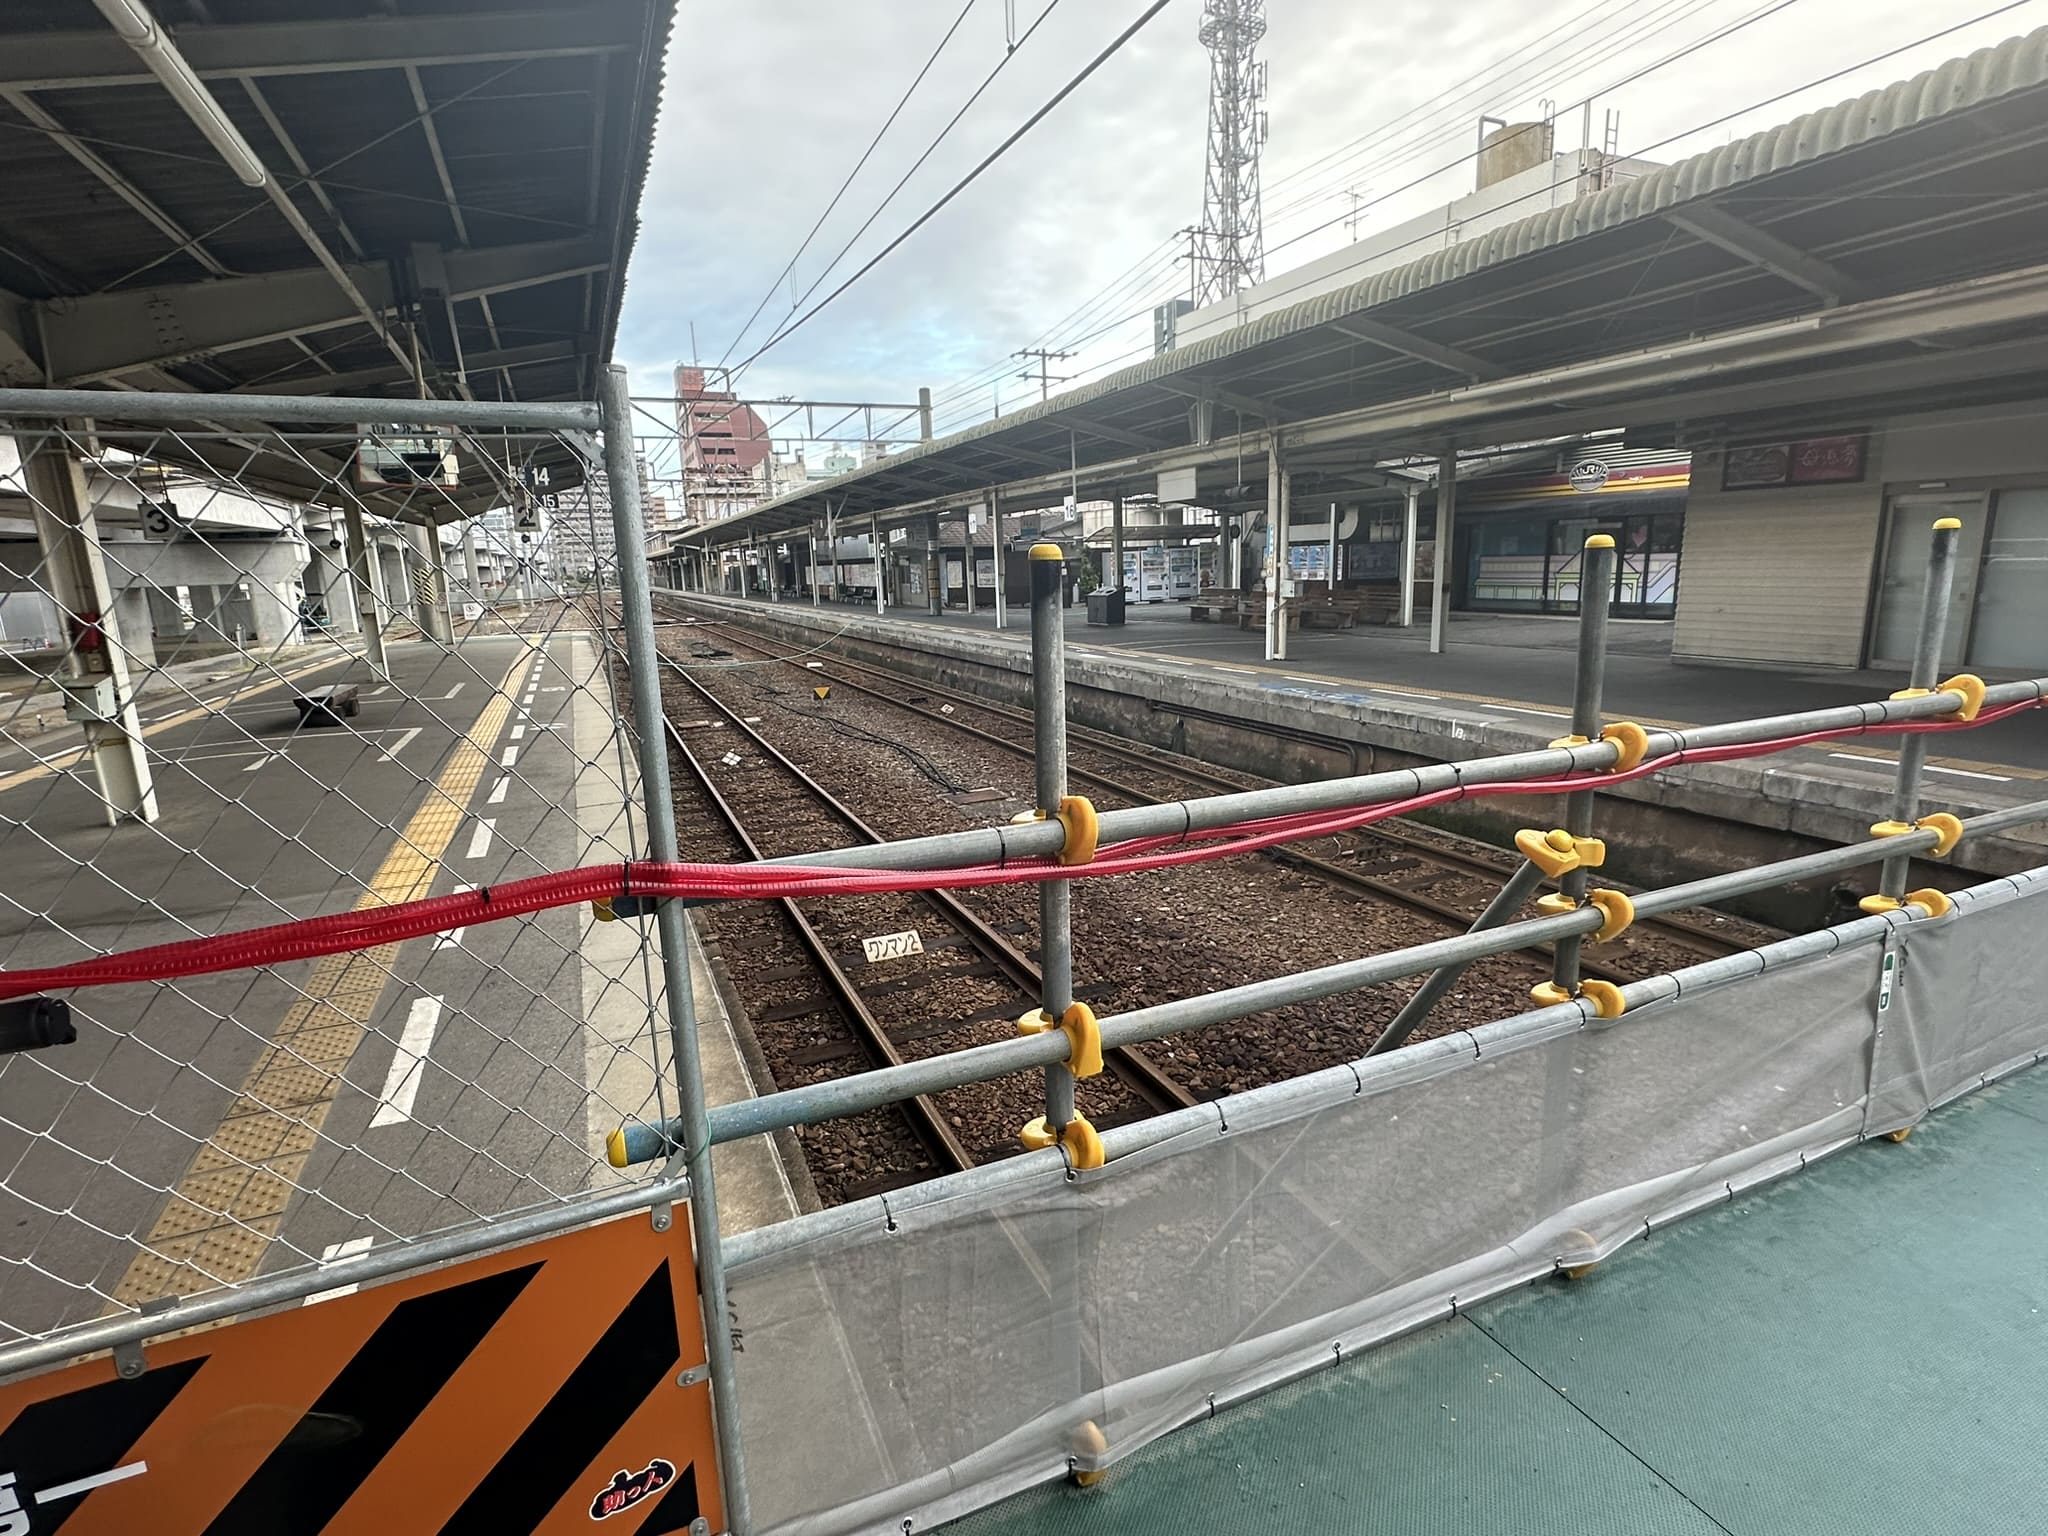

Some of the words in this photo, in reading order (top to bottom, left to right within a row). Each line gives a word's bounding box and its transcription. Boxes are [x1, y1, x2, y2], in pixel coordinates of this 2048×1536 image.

[532, 466, 550, 486] 14
[541, 493, 556, 508] 15
[146, 509, 170, 534] 3
[517, 506, 537, 527] 2
[1065, 504, 1074, 519] 16
[602, 1471, 664, 1514] 助っ人
